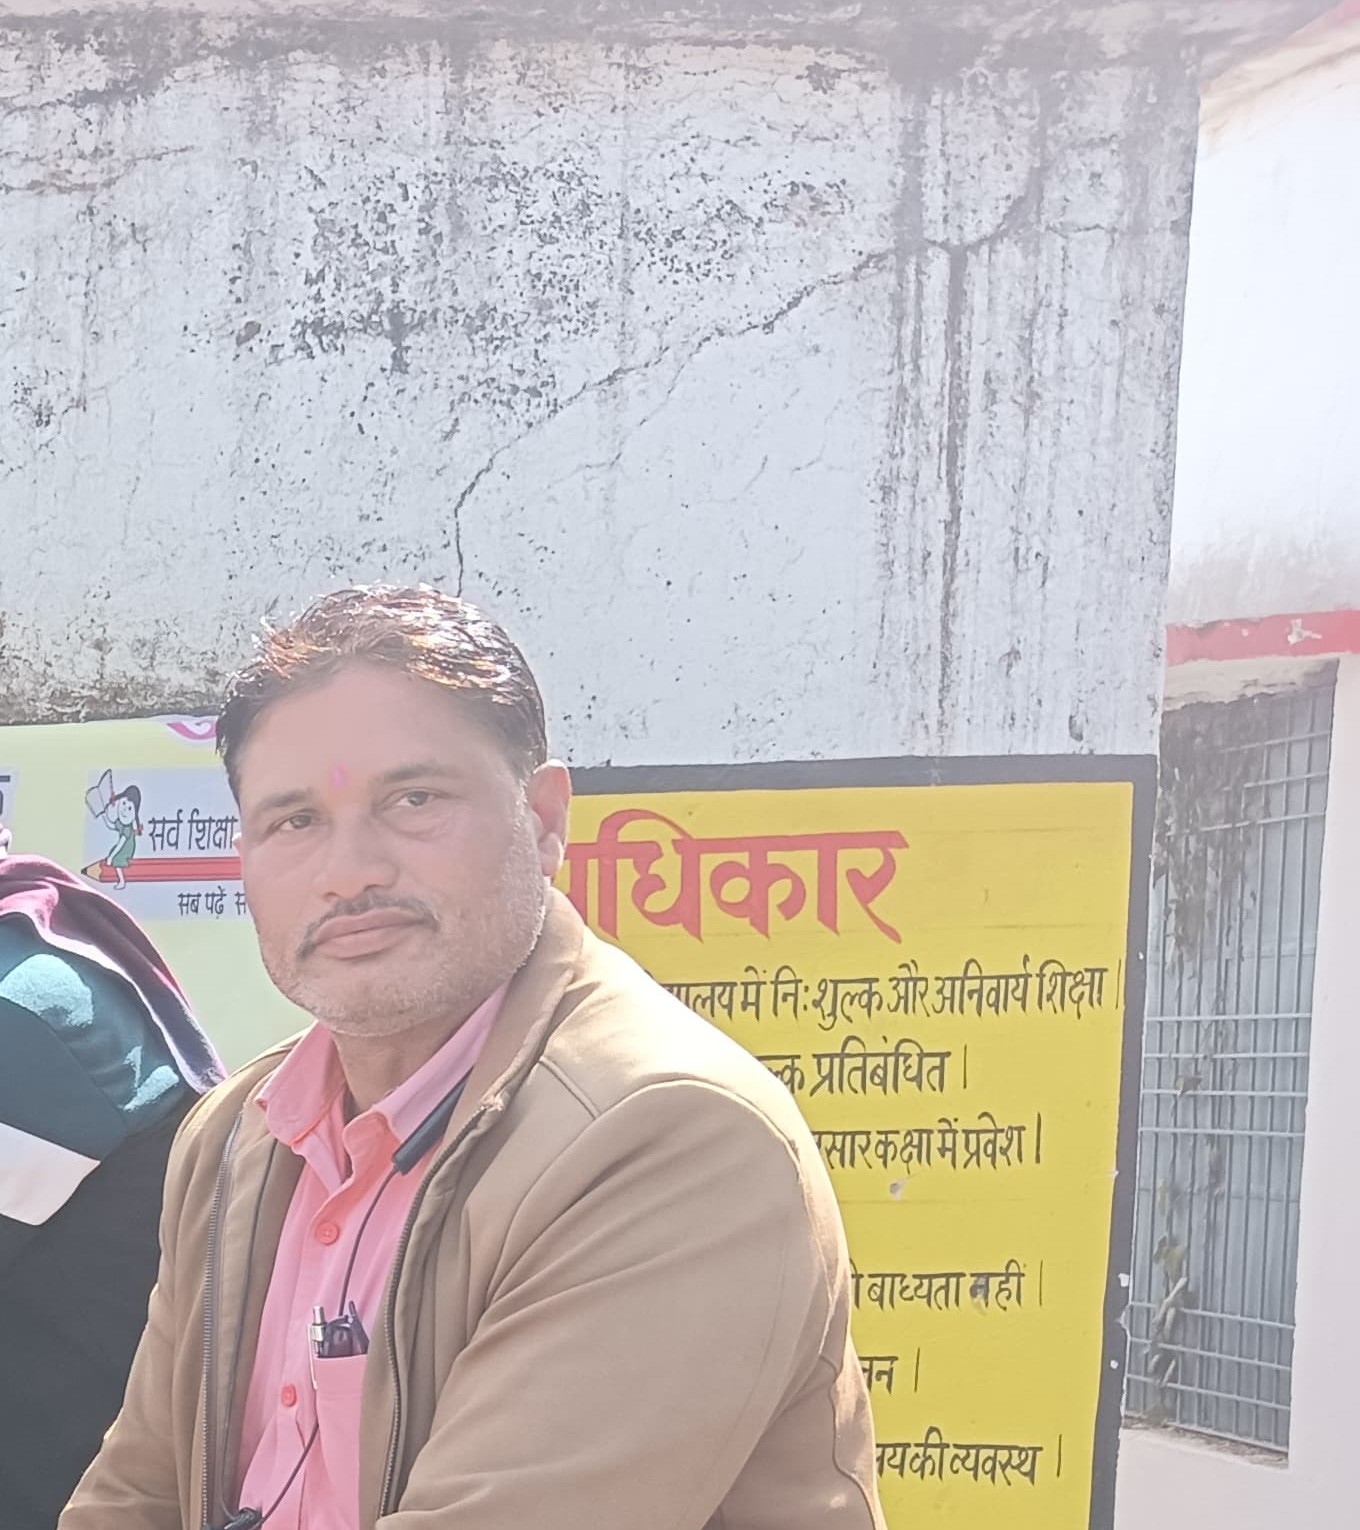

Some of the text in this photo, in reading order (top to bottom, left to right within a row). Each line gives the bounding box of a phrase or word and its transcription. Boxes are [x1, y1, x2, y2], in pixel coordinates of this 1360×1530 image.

[148, 807, 238, 852] सर्व शिक्षा
[178, 893, 201, 915] सब
[740, 965, 766, 1021] में
[887, 959, 930, 1017] और
[931, 954, 1032, 1017] अनिवार्य
[809, 1035, 952, 1097] प्रतिबंधित
[937, 1117, 959, 1170] में
[962, 1111, 1026, 1170] प्रवेश
[867, 1271, 967, 1311] बाध्यता
